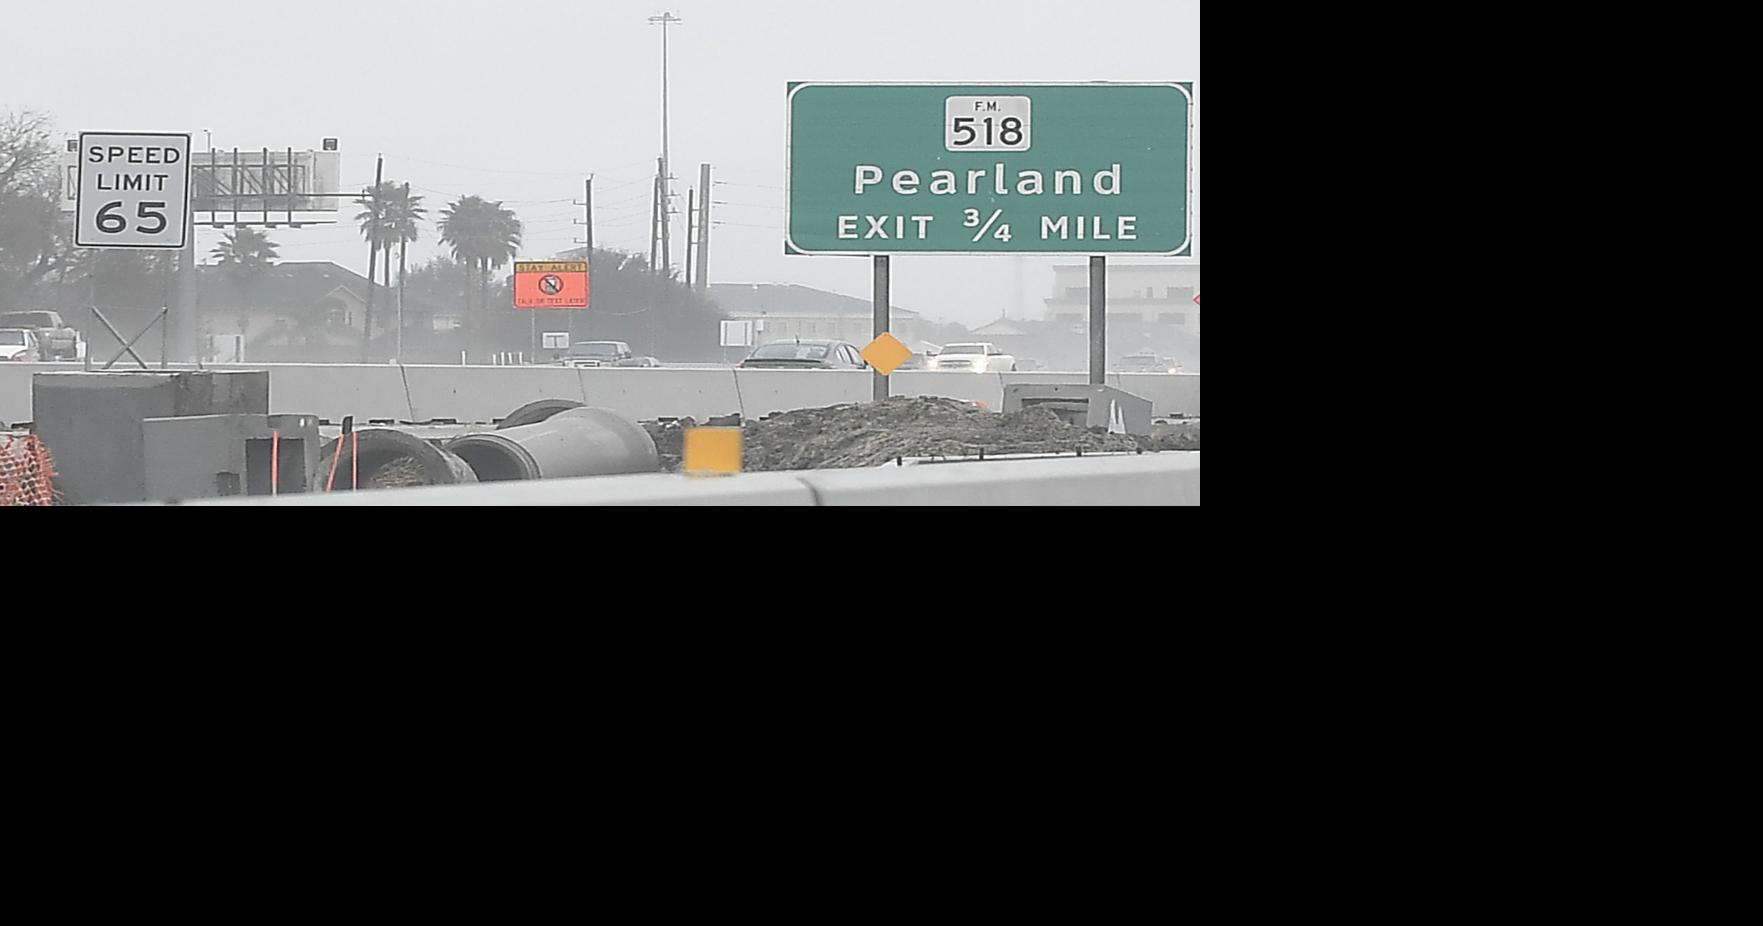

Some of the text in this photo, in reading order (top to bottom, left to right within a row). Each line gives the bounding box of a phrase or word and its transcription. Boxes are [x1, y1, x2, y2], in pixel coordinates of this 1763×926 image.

[975, 101, 1000, 112] F.M.
[953, 116, 1023, 146] 518
[88, 146, 180, 164] SPEED
[97, 173, 168, 191] LIMIT
[854, 163, 1122, 195] Pearland
[95, 201, 167, 234] 65
[838, 215, 933, 240] EXIT
[1041, 215, 1137, 241] MILE
